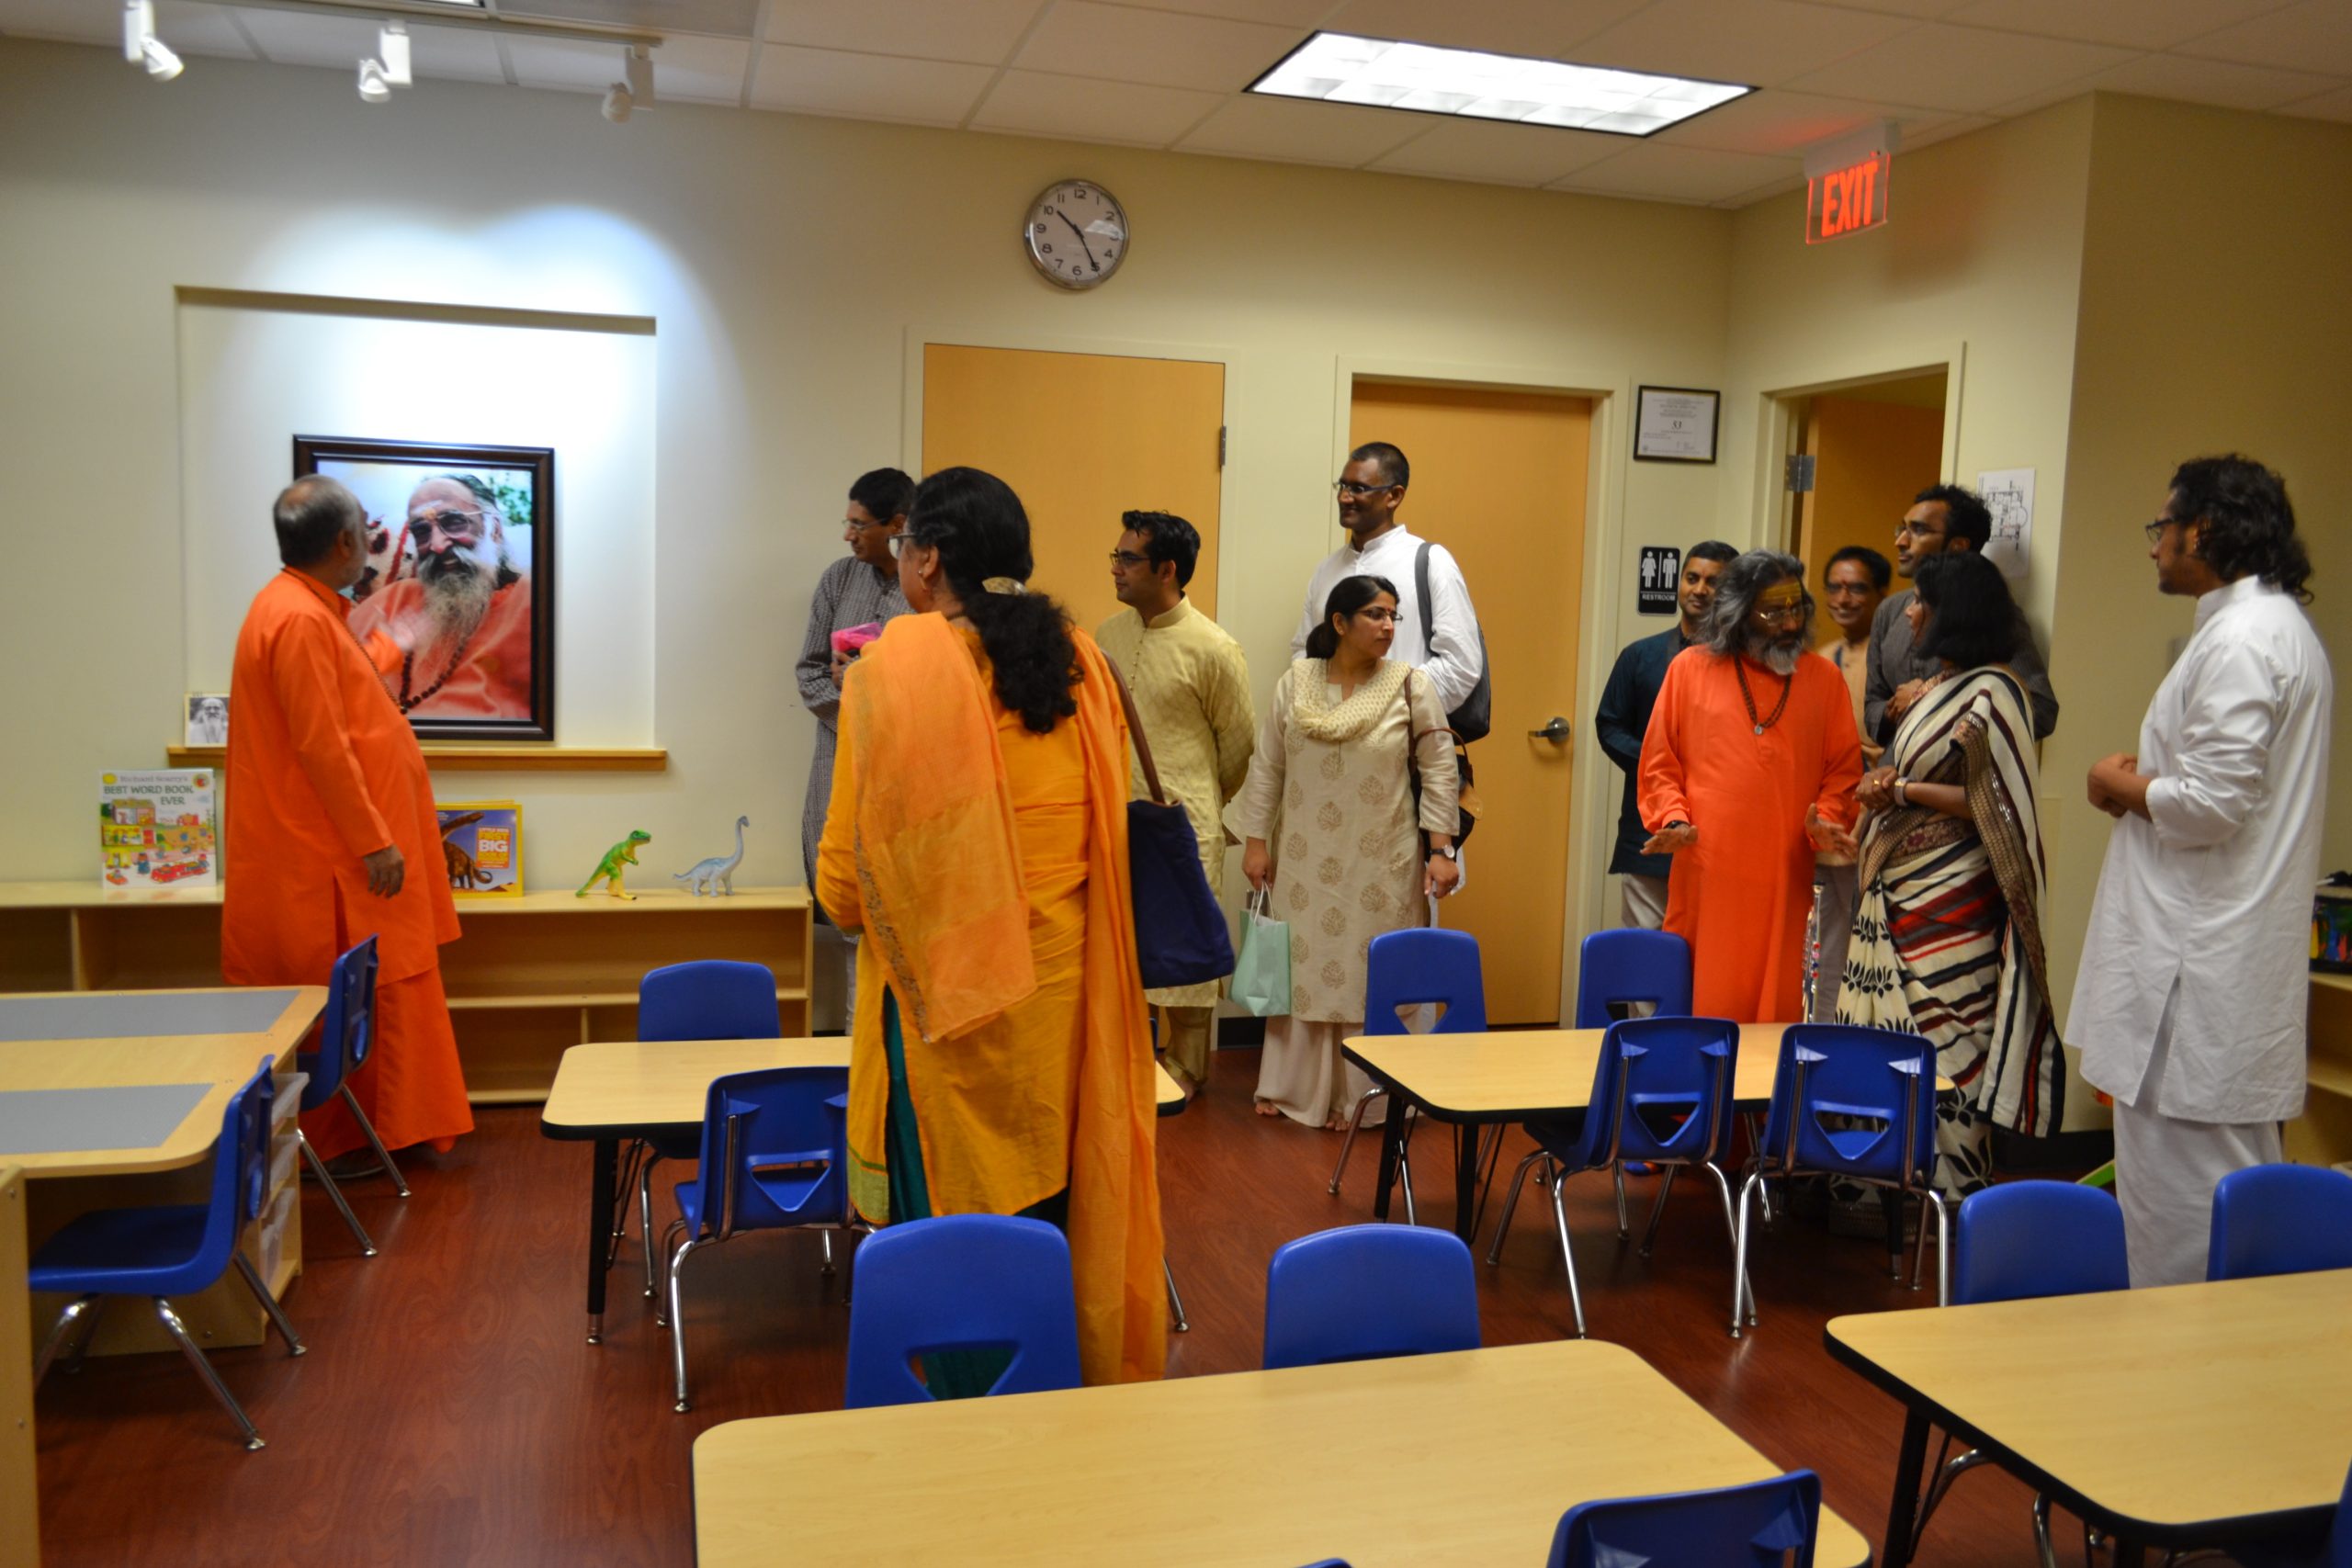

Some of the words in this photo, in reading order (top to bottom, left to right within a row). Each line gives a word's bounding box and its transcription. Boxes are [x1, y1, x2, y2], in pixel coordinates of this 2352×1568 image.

[1074, 188, 1086, 199] 12
[1821, 160, 1879, 237] EXIT
[1057, 194, 1065, 204] 11
[1044, 205, 1054, 215] 10
[1104, 211, 1114, 221] 2
[1036, 223, 1046, 233] 9
[1042, 243, 1053, 254] 8
[1104, 249, 1114, 259] 4
[1055, 259, 1064, 269] 7
[1072, 265, 1082, 276] 6
[1642, 593, 1676, 602] RESTROOM
[103, 785, 128, 795] BEST
[130, 785, 163, 795] WORD
[165, 785, 194, 795] BOOK
[160, 796, 186, 806] EVER
[478, 840, 508, 852] BIG
